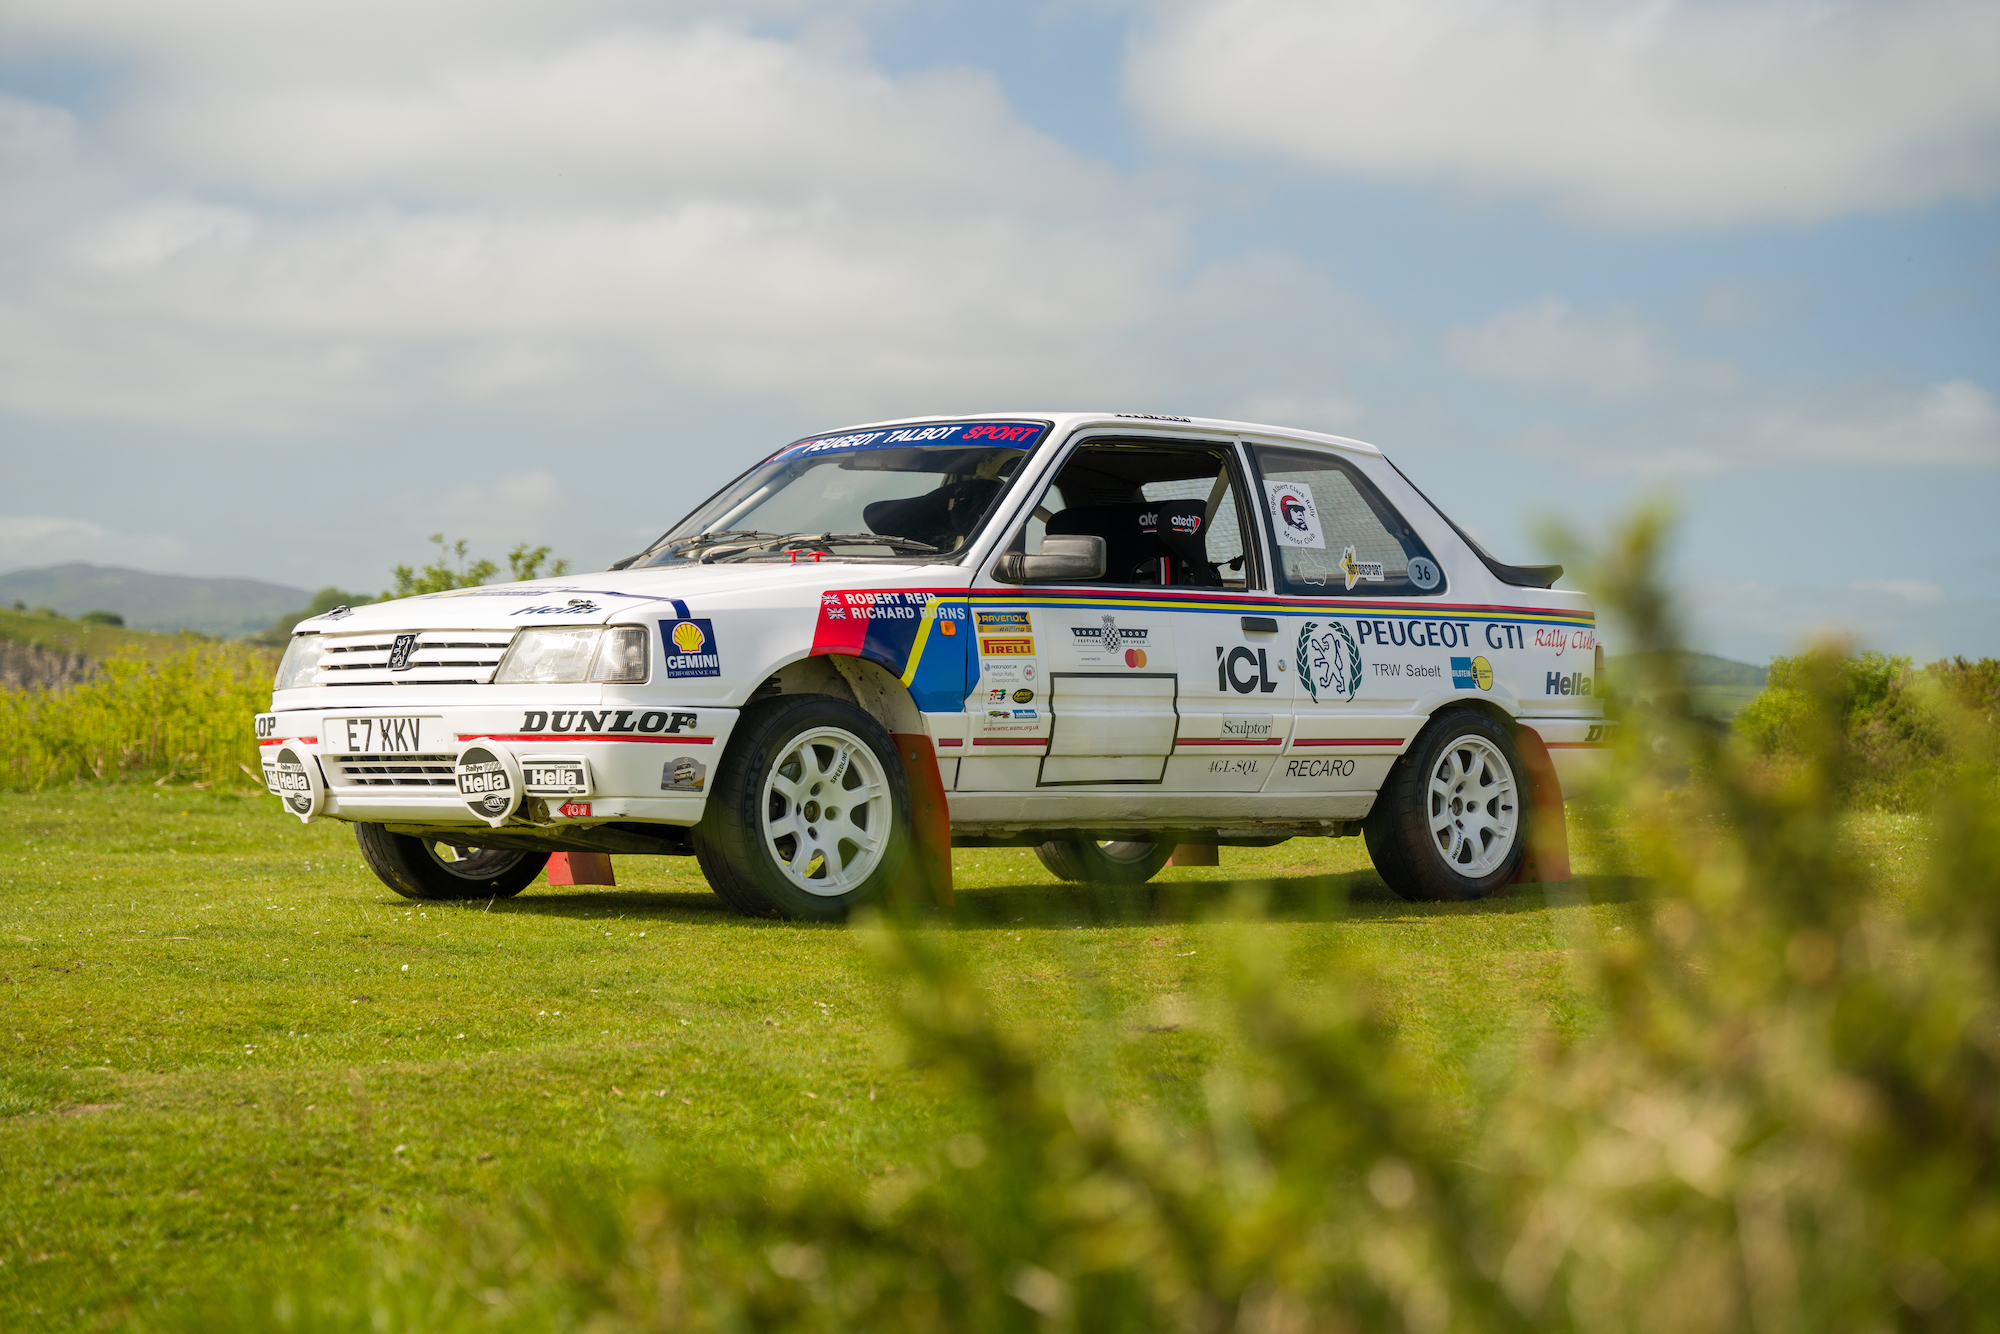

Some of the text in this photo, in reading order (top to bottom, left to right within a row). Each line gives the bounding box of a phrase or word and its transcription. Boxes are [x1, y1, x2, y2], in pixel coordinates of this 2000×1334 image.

[802, 426, 1039, 454] PEUGEOT TALBOT SPORT
[1283, 530, 1316, 545] Motor Club
[1415, 564, 1431, 581] 36
[844, 592, 937, 605] ROBERT REID
[850, 607, 966, 620] RICHARD BURNS
[1356, 619, 1595, 656] PEUGEOT GTI Rally Club
[983, 639, 1031, 654] PIRELLI
[667, 654, 718, 669] GEMINI
[1372, 663, 1441, 677] TRW Sabelt
[1545, 671, 1592, 696] Hella
[519, 710, 698, 734] DUNLOP
[1222, 720, 1272, 738] Sculptor
[346, 718, 420, 752] E7 XKV
[465, 763, 483, 773] Rallye
[830, 751, 848, 784] SPEEDLINE
[1208, 760, 1259, 776] 4GL-SQL
[1286, 759, 1355, 777] RECARO
[278, 772, 308, 791] Hella
[461, 772, 506, 794] Hella
[531, 769, 577, 785] Hella
[565, 804, 588, 816] TOW
